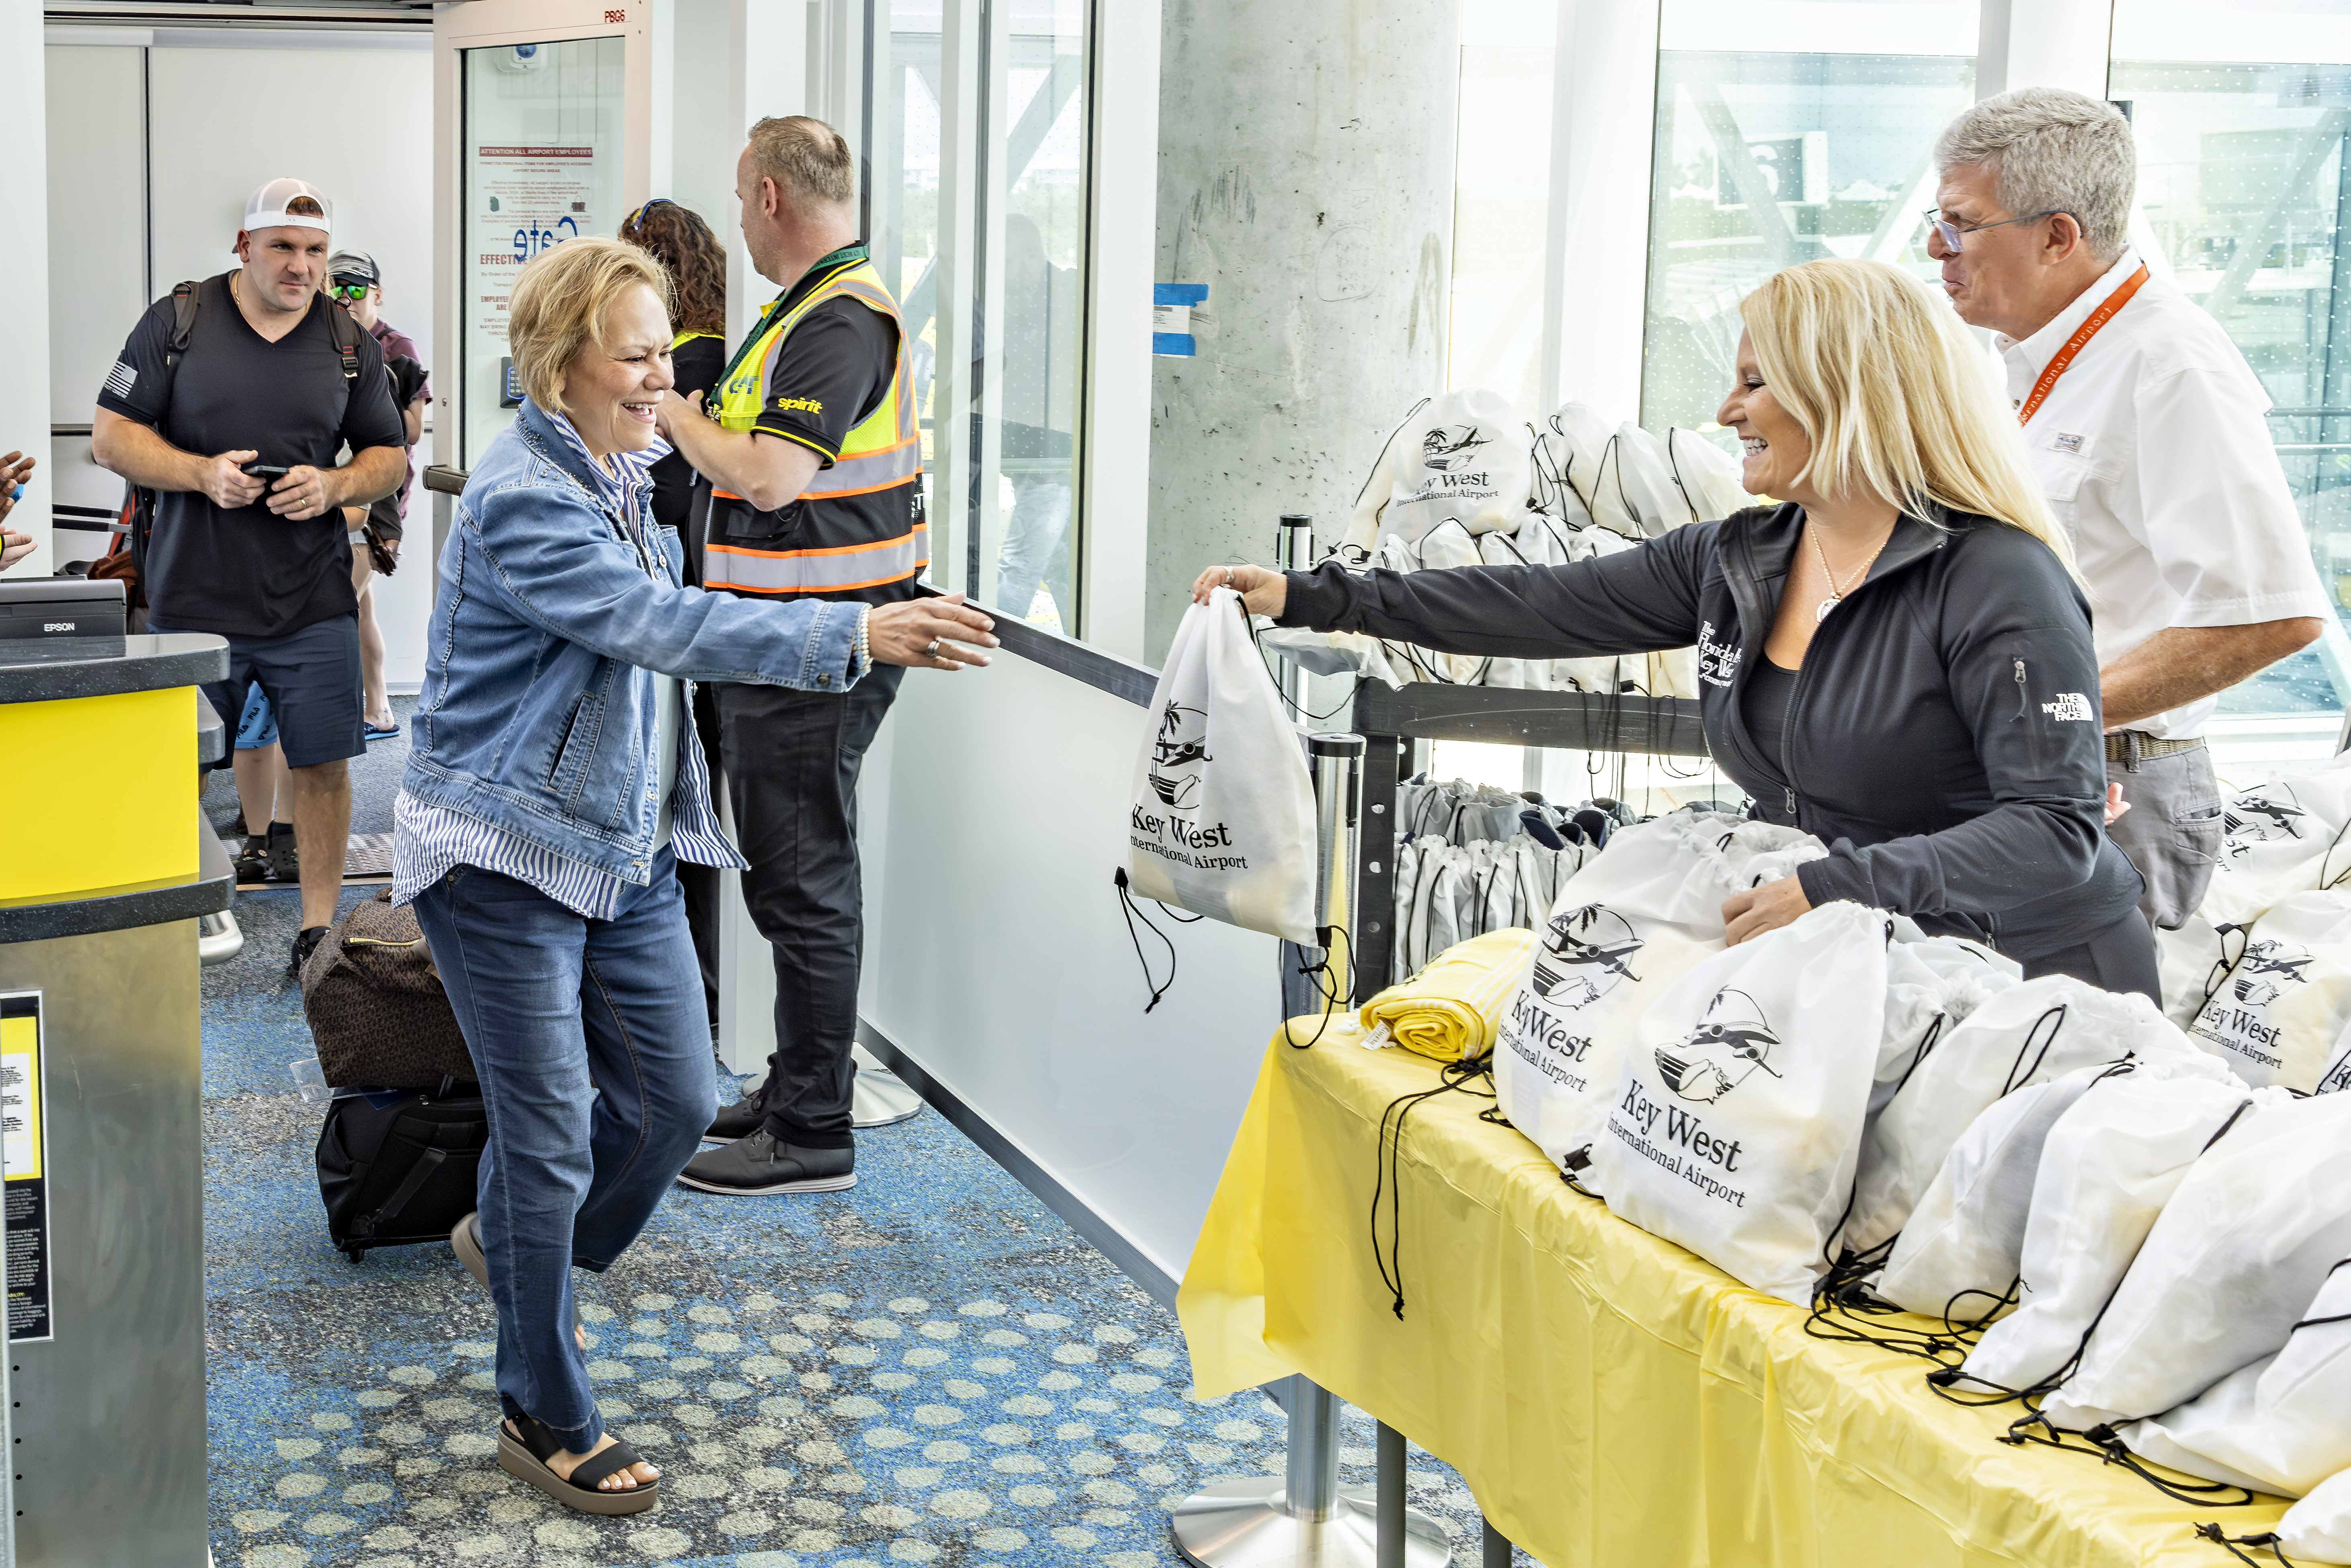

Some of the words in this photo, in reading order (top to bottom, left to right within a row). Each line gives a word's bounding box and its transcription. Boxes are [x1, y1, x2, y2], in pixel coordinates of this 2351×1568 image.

[605, 9, 625, 23] PBG6
[2020, 356, 2069, 420] rnational
[2070, 307, 2113, 351] Airport
[778, 397, 823, 414] spirit
[1441, 471, 1490, 488] West
[1458, 488, 1499, 500] Airport
[43, 622, 75, 632] EPSON
[1699, 650, 1719, 675] Key
[2042, 702, 2080, 713] NORTH
[2056, 693, 2078, 703] THE
[2054, 711, 2081, 721] FACE
[1132, 803, 1165, 843] Key
[1169, 815, 1232, 849] West
[1131, 835, 1193, 867] nternational
[1195, 855, 1248, 871] Airport
[1531, 1005, 1593, 1062] West
[2201, 1000, 2232, 1030] Key
[2232, 1008, 2282, 1047] West
[2189, 1024, 2241, 1051] nternational
[2239, 1043, 2283, 1069] Airport
[1539, 1056, 1587, 1092] Airport
[1621, 1078, 1662, 1136] Key
[1668, 1104, 1743, 1172] West
[1607, 1111, 1683, 1175] International
[1683, 1164, 1746, 1208] Airport
